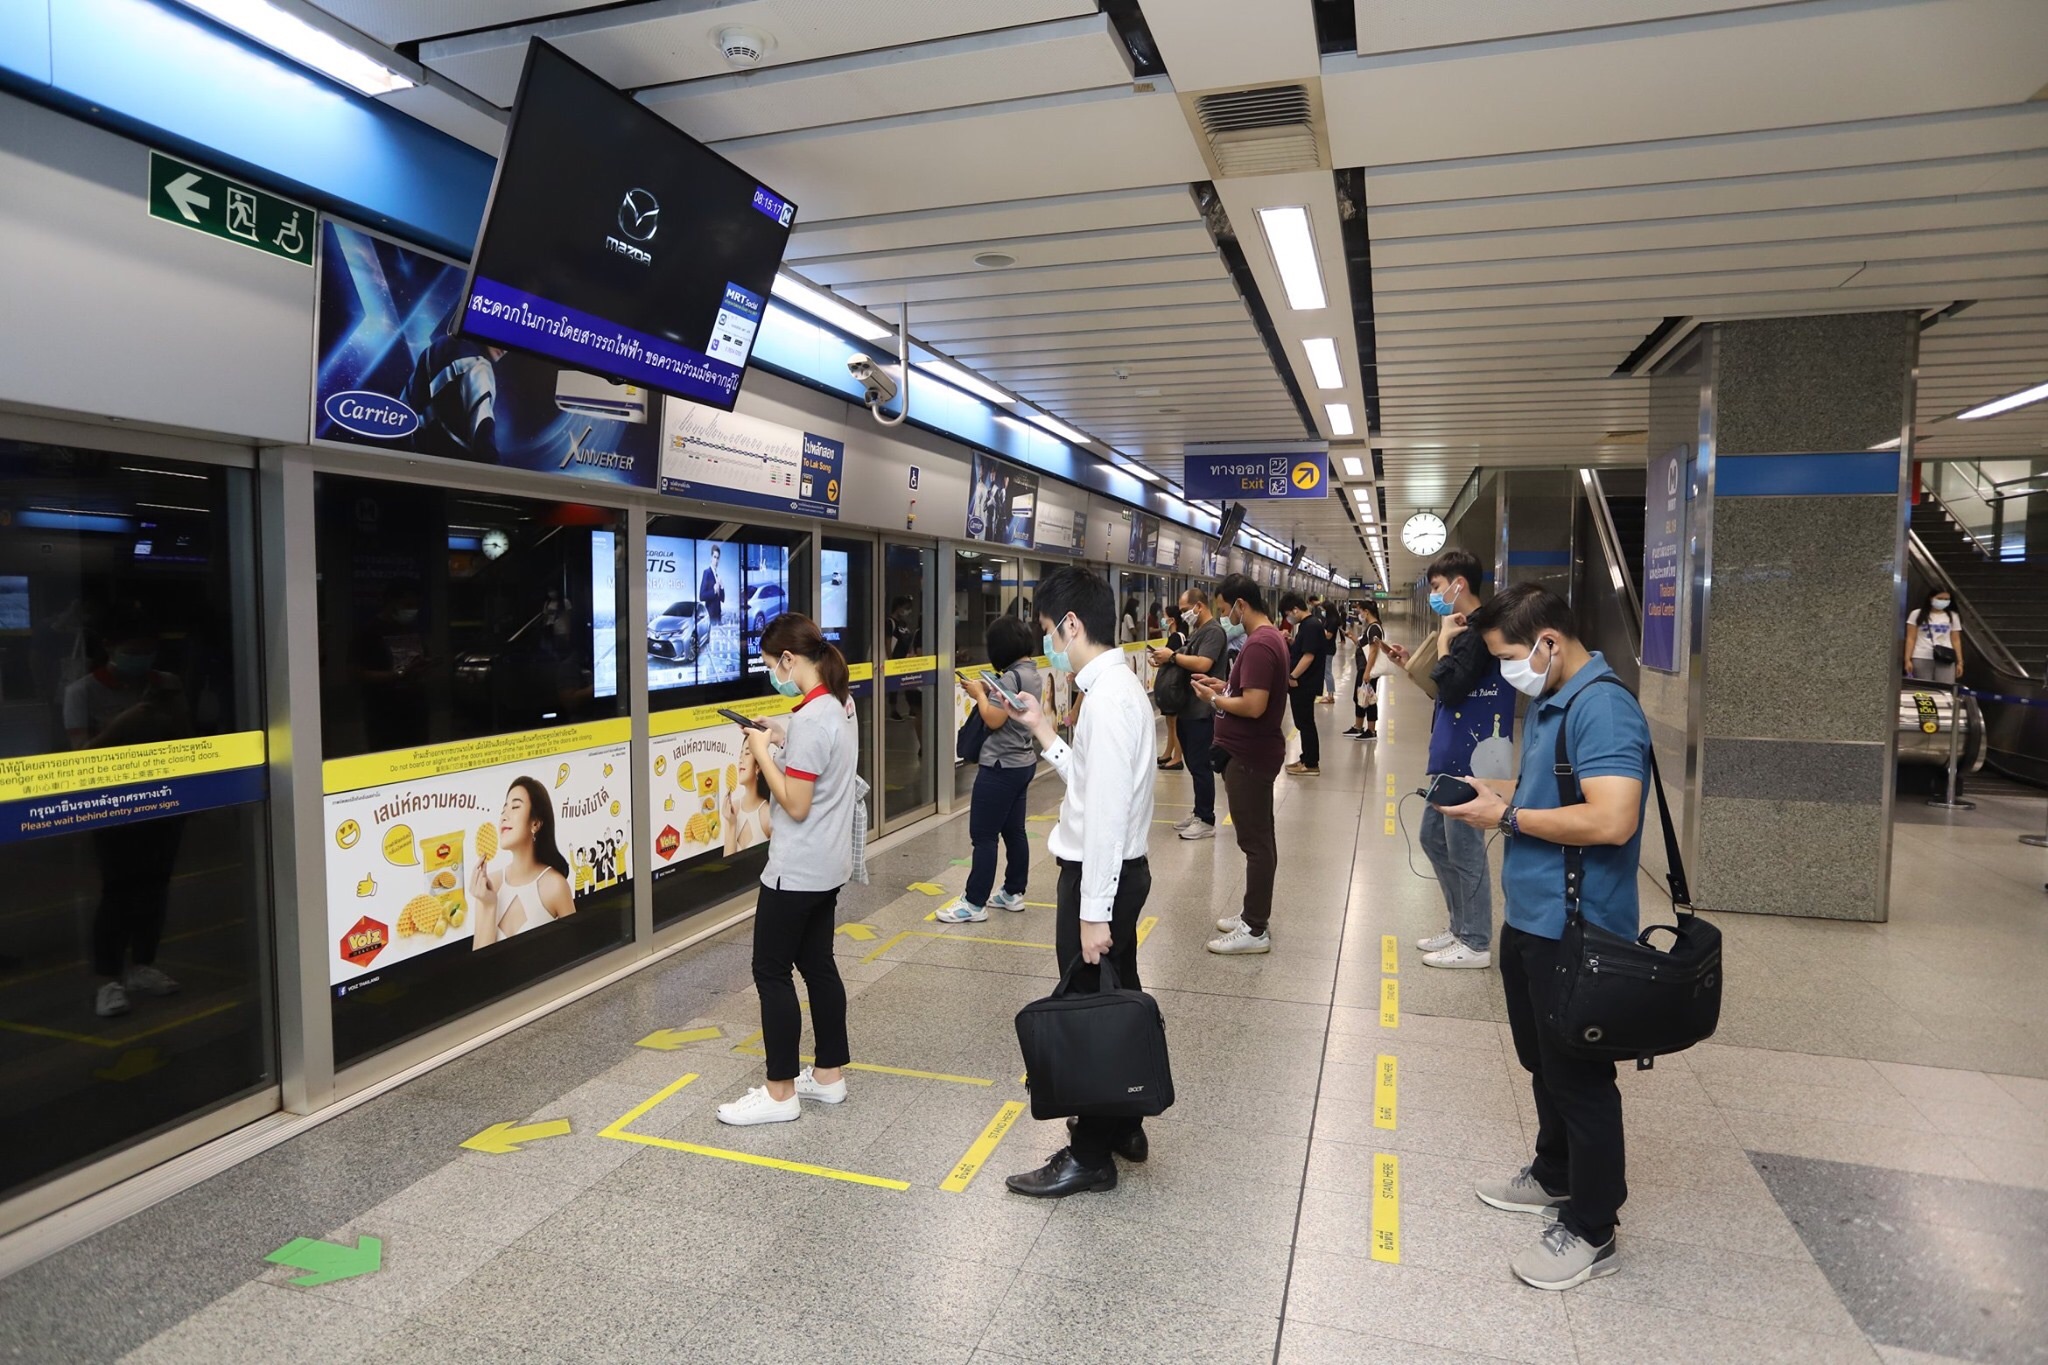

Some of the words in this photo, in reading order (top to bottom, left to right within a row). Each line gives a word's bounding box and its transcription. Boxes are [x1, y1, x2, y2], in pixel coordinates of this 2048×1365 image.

[754, 190, 782, 215] 08:15:17
[605, 235, 652, 266] mazda
[726, 288, 747, 304] MRT
[468, 293, 643, 361] สะดวกในการโดยสารรถไฟฟ้า
[338, 398, 409, 428] Carrier
[1209, 464, 1265, 476] ทางออก
[1241, 477, 1265, 490] Exit
[0, 775, 34, 787] senger
[37, 771, 54, 781] exit
[57, 768, 74, 778] first
[77, 766, 94, 775] and
[97, 764, 109, 773] be
[112, 759, 140, 771] careful
[143, 759, 151, 768] of
[153, 757, 166, 766] the
[168, 754, 196, 764] closing
[21, 820, 52, 832] Please
[53, 816, 74, 826] wait
[76, 810, 108, 822] behind
[109, 807, 132, 818] entry
[134, 804, 158, 813] arrow
[159, 800, 180, 810] signs
[1384, 1062, 1393, 1073] HERE
[1128, 1085, 1144, 1093] acer
[1384, 1073, 1393, 1087] STAND
[988, 1122, 1007, 1139] STAND
[1002, 1109, 1017, 1121] HERE
[1383, 1162, 1394, 1178] HERE
[1382, 1178, 1394, 1199] STAND
